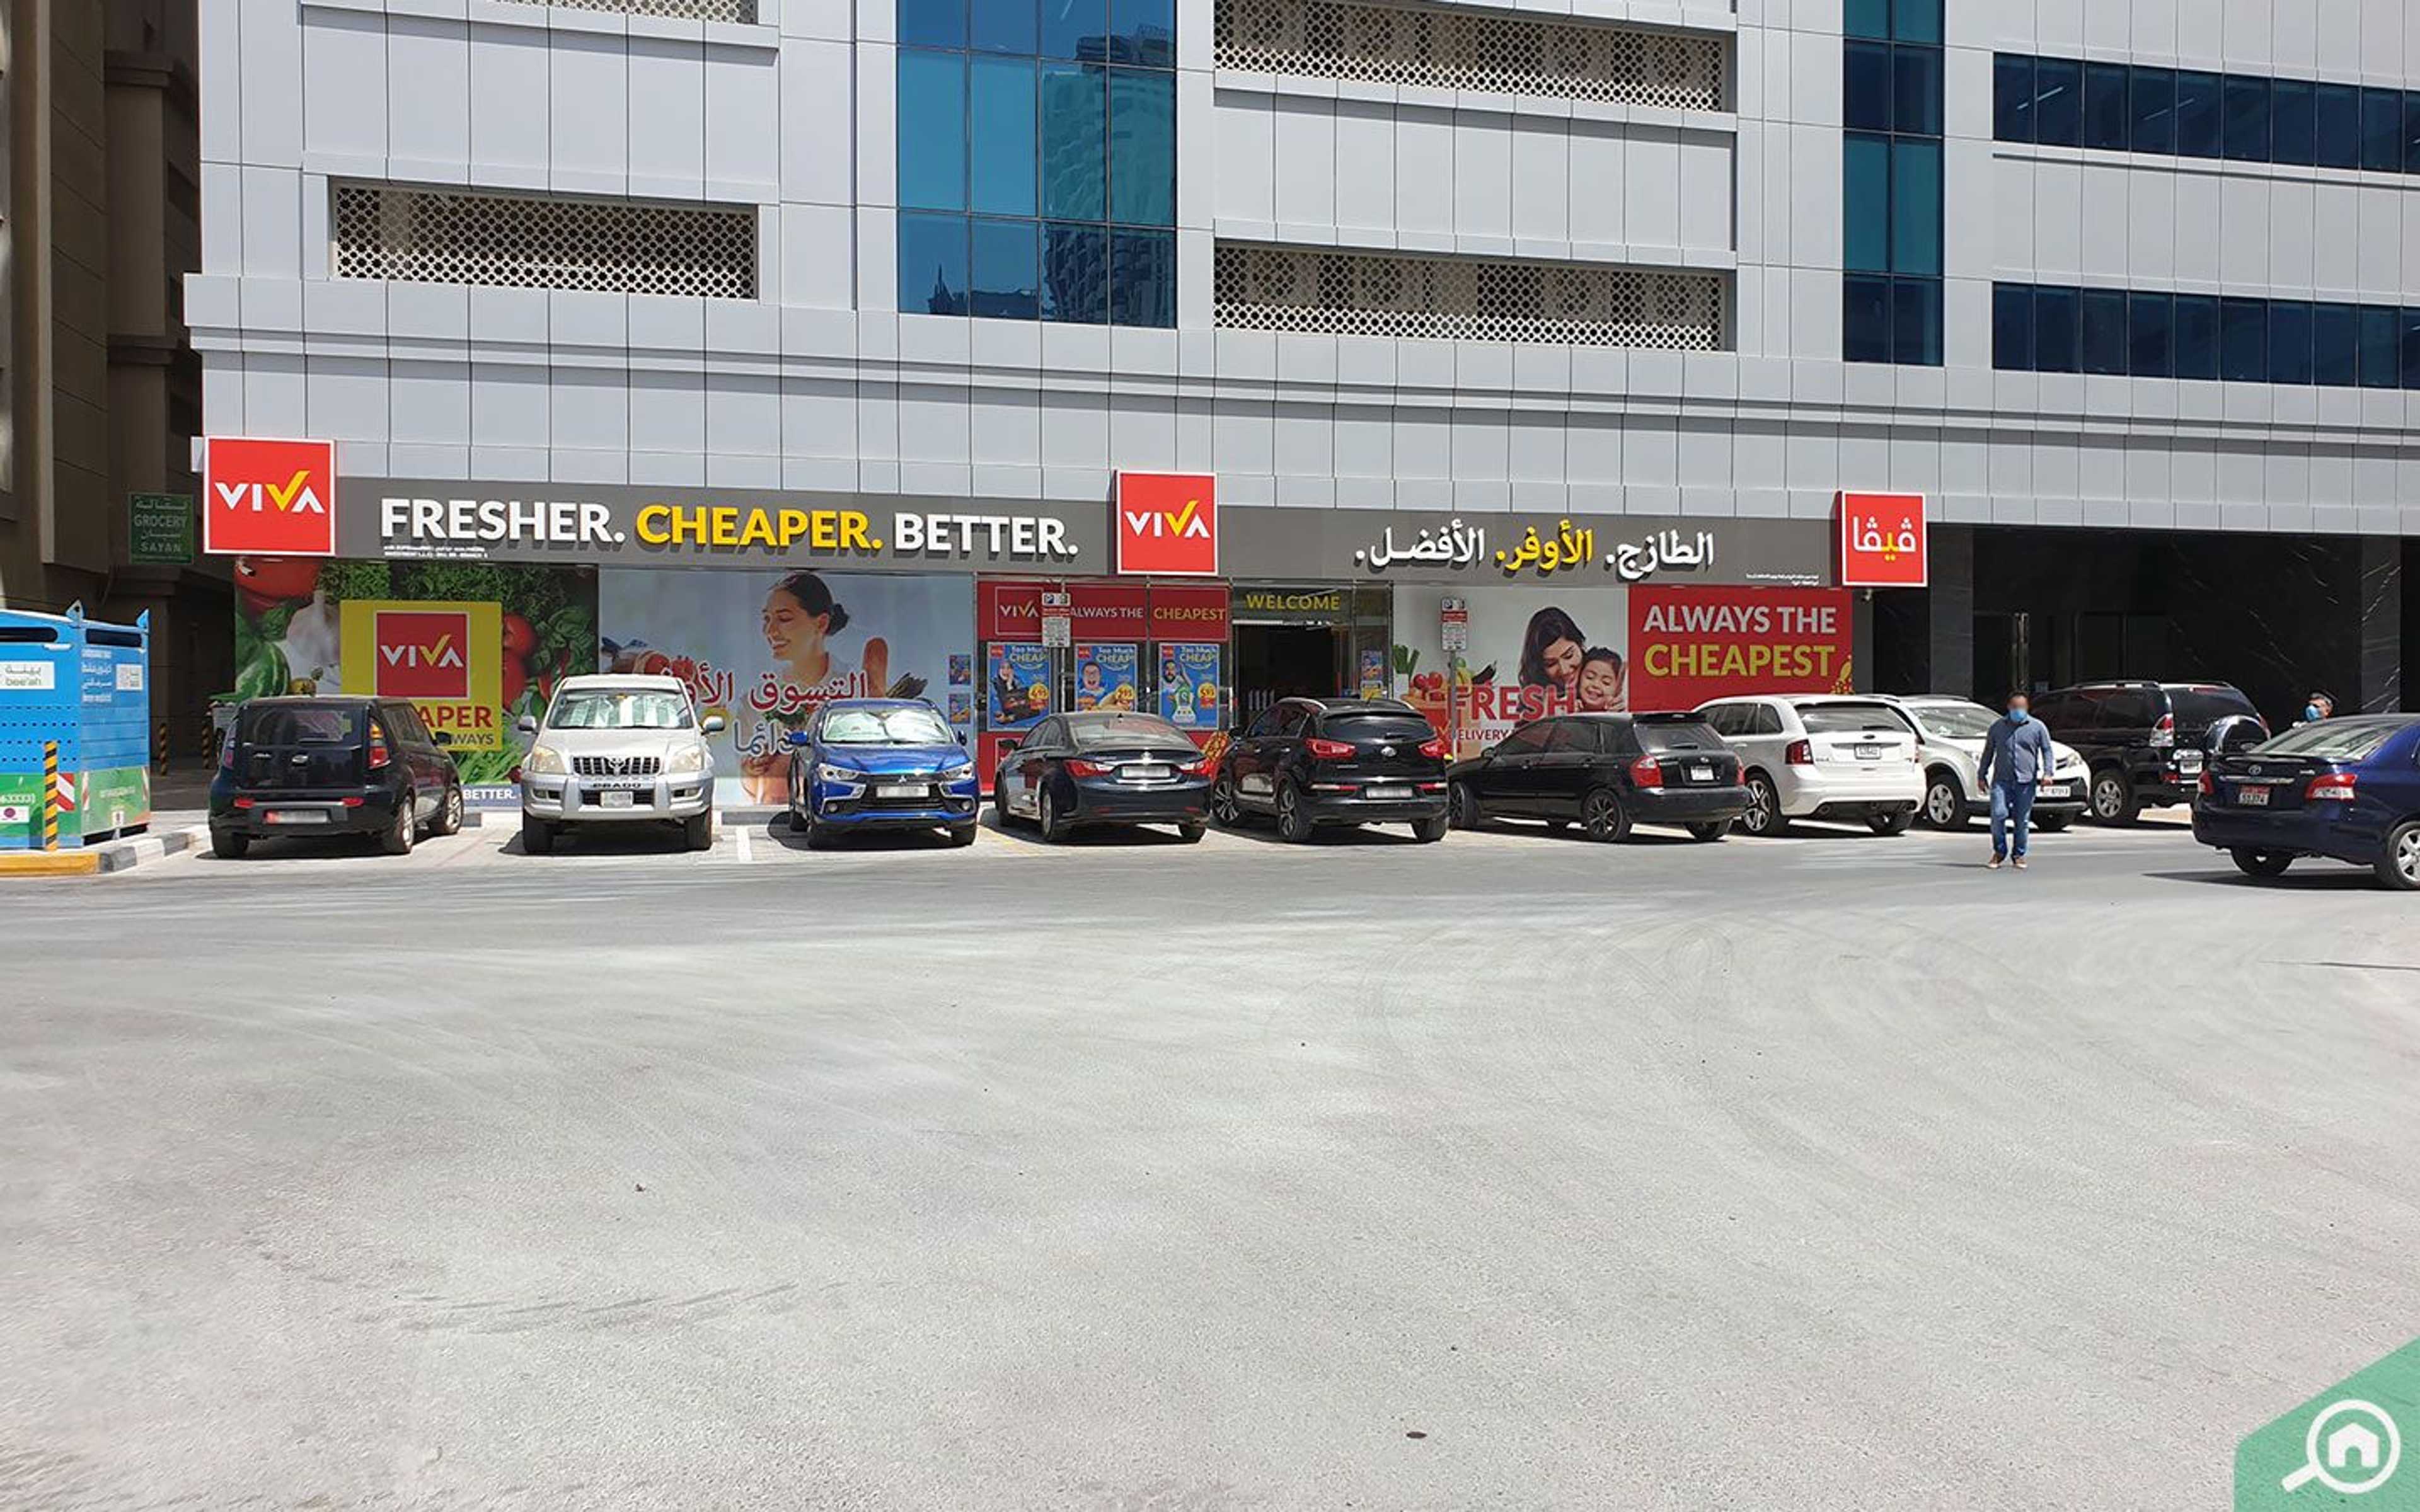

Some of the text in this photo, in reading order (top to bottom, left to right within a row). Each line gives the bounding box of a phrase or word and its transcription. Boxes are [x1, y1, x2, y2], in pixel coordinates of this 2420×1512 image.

[215, 470, 325, 514] VIVA
[134, 513, 188, 528] GROCERY
[381, 498, 1080, 556] FRESHER. CHEAPER. BETTER.
[1124, 500, 1211, 539] VIVA
[140, 542, 182, 553] SAYAN
[1355, 518, 1714, 580] الطازج. الأوفر. الأفضل.
[1000, 600, 1039, 618] VIVA
[1071, 607, 1117, 617] ALWAYS
[1121, 607, 1144, 618] THE
[1153, 608, 1225, 621] CHEAPEST
[1245, 594, 1341, 610] WELCOME
[1643, 604, 1837, 634] ALWAYS THE
[380, 634, 464, 668] VIVA
[1644, 643, 1836, 677] CHEAPEST
[749, 671, 869, 714] التسوق
